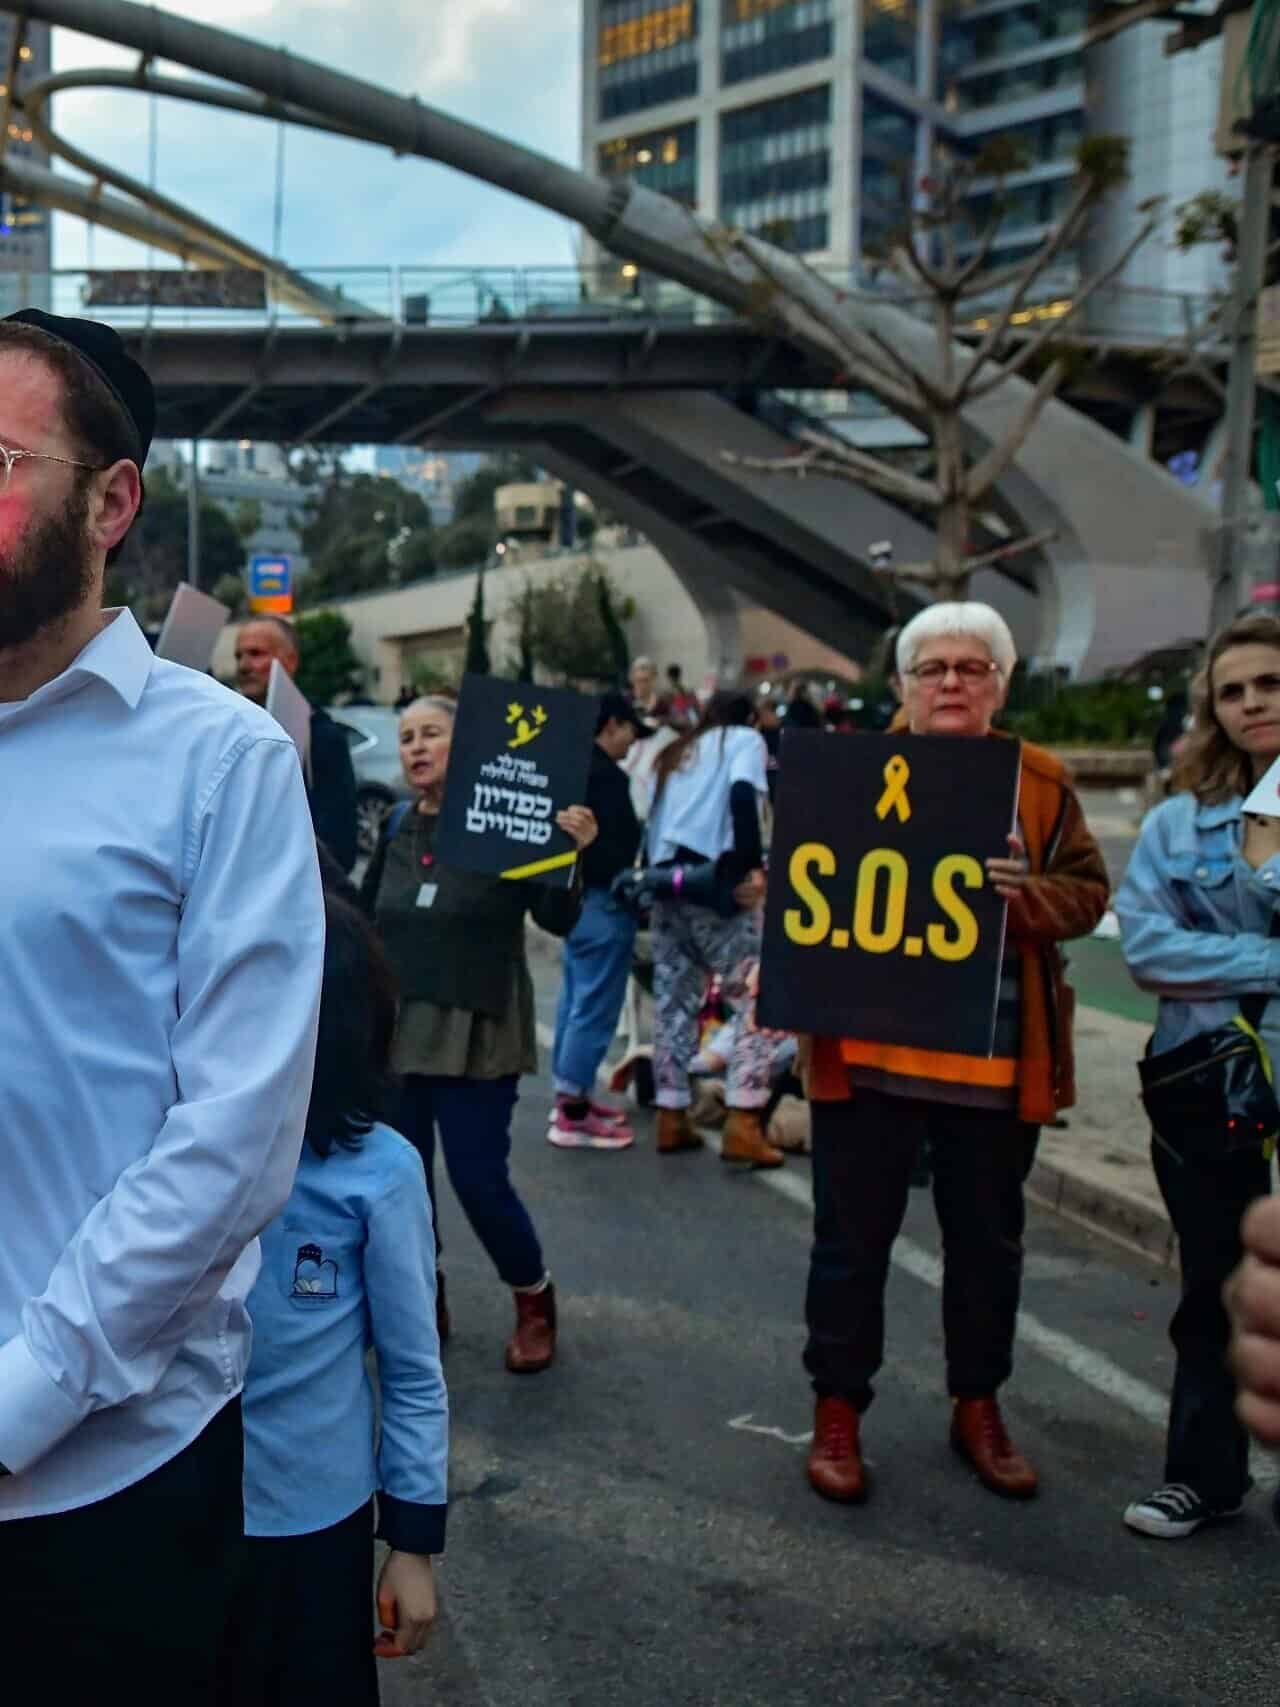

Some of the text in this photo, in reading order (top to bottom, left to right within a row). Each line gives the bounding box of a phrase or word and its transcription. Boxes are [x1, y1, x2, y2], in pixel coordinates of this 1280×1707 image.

[474, 783, 553, 819] כפדיון
[466, 807, 553, 844] שבויים
[783, 841, 985, 962] S.O.S
